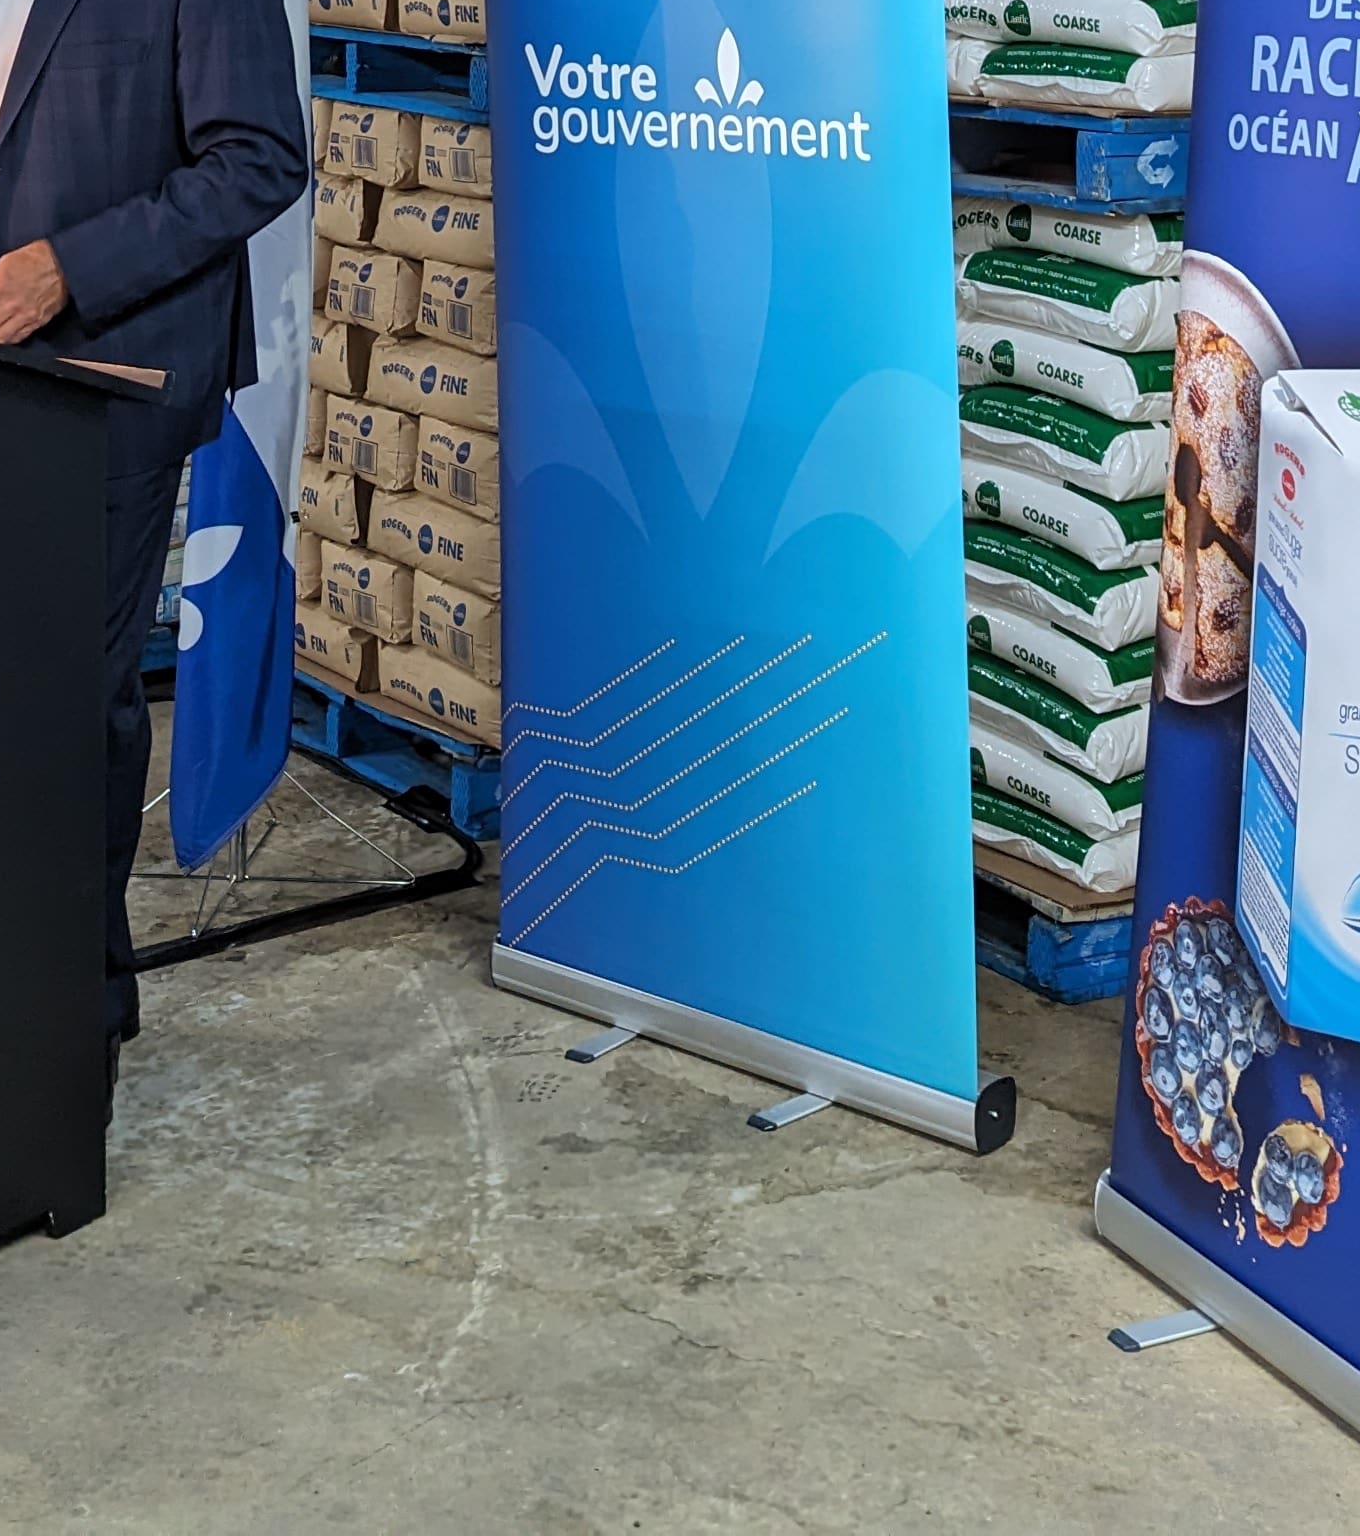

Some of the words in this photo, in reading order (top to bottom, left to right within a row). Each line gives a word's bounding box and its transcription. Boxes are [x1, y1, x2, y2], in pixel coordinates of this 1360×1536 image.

[404, 1, 432, 17] ROGERS
[454, 5, 479, 23] FINE
[1053, 14, 1100, 33] COARSE
[524, 41, 657, 100] Votre
[532, 103, 870, 163] gouvernement
[1228, 111, 1339, 160] OCÉAN
[394, 205, 426, 222] ROGERS
[451, 212, 480, 230] FINE
[954, 210, 1000, 230] OGERS
[1054, 222, 1102, 245] COARSE
[422, 305, 438, 327] FIN
[382, 363, 415, 382] ROGERS
[440, 374, 468, 396] FINE
[991, 350, 1012, 364] Lantic
[1037, 361, 1085, 389] COARSE
[422, 465, 439, 488] FIN
[302, 486, 319, 507] FIN
[1022, 505, 1069, 537] COARSE
[381, 518, 412, 540] ROGERS
[438, 536, 464, 562] FINE
[329, 593, 345, 615] FIN
[310, 635, 327, 655] FIN
[1012, 644, 1057, 679] COARSE
[390, 678, 423, 702] ROGERS
[449, 701, 478, 726] FINE
[1007, 775, 1052, 809] COARSE
